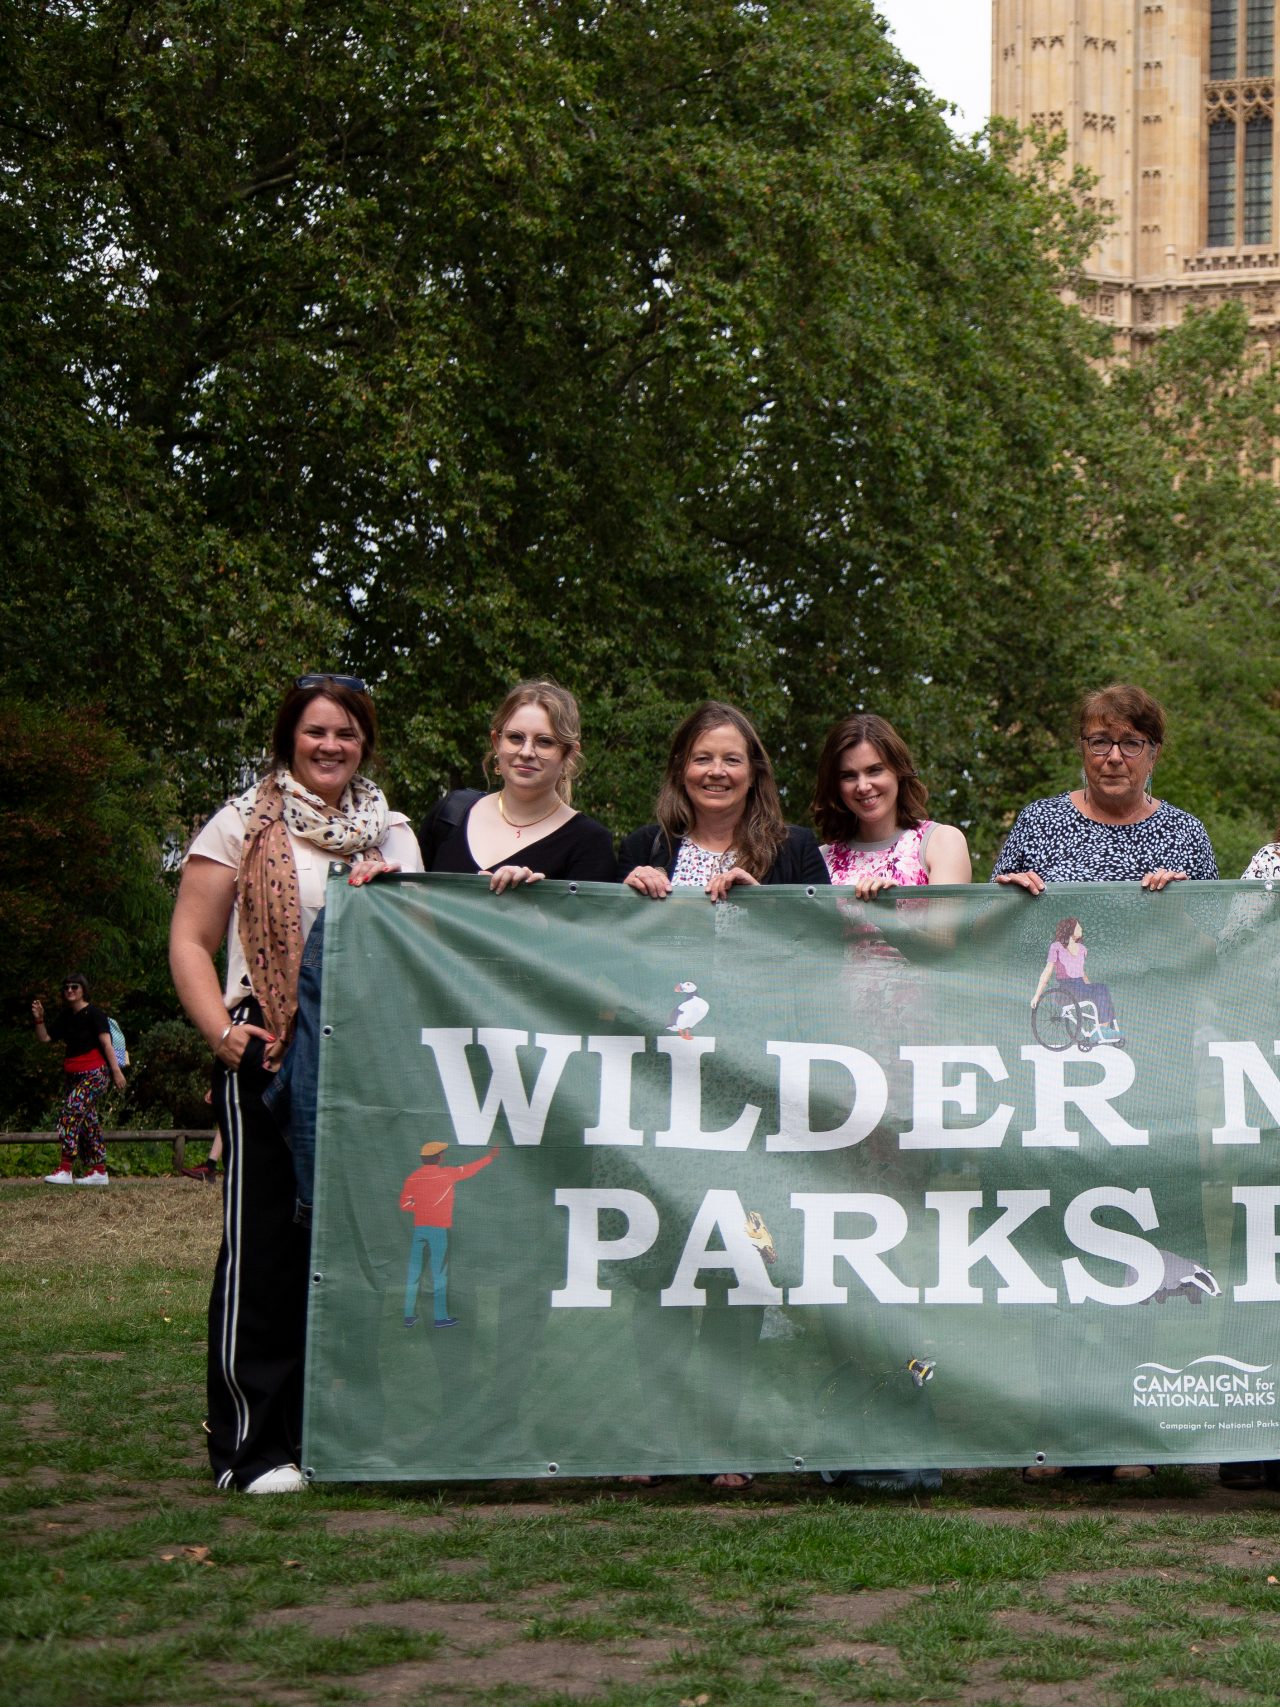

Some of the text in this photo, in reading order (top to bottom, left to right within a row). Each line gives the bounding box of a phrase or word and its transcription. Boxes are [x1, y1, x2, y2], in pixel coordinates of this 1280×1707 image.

[421, 1027, 1149, 1152] WILDER
[551, 1187, 1166, 1306] PARKS
[1134, 1374, 1275, 1392] CAMPAIGN for
[1133, 1391, 1276, 1407] NATIONAL PARKS
[1159, 1421, 1202, 1431] Campaign
[1204, 1421, 1216, 1430] for
[1218, 1420, 1254, 1430] National
[1256, 1419, 1279, 1428] Parks
